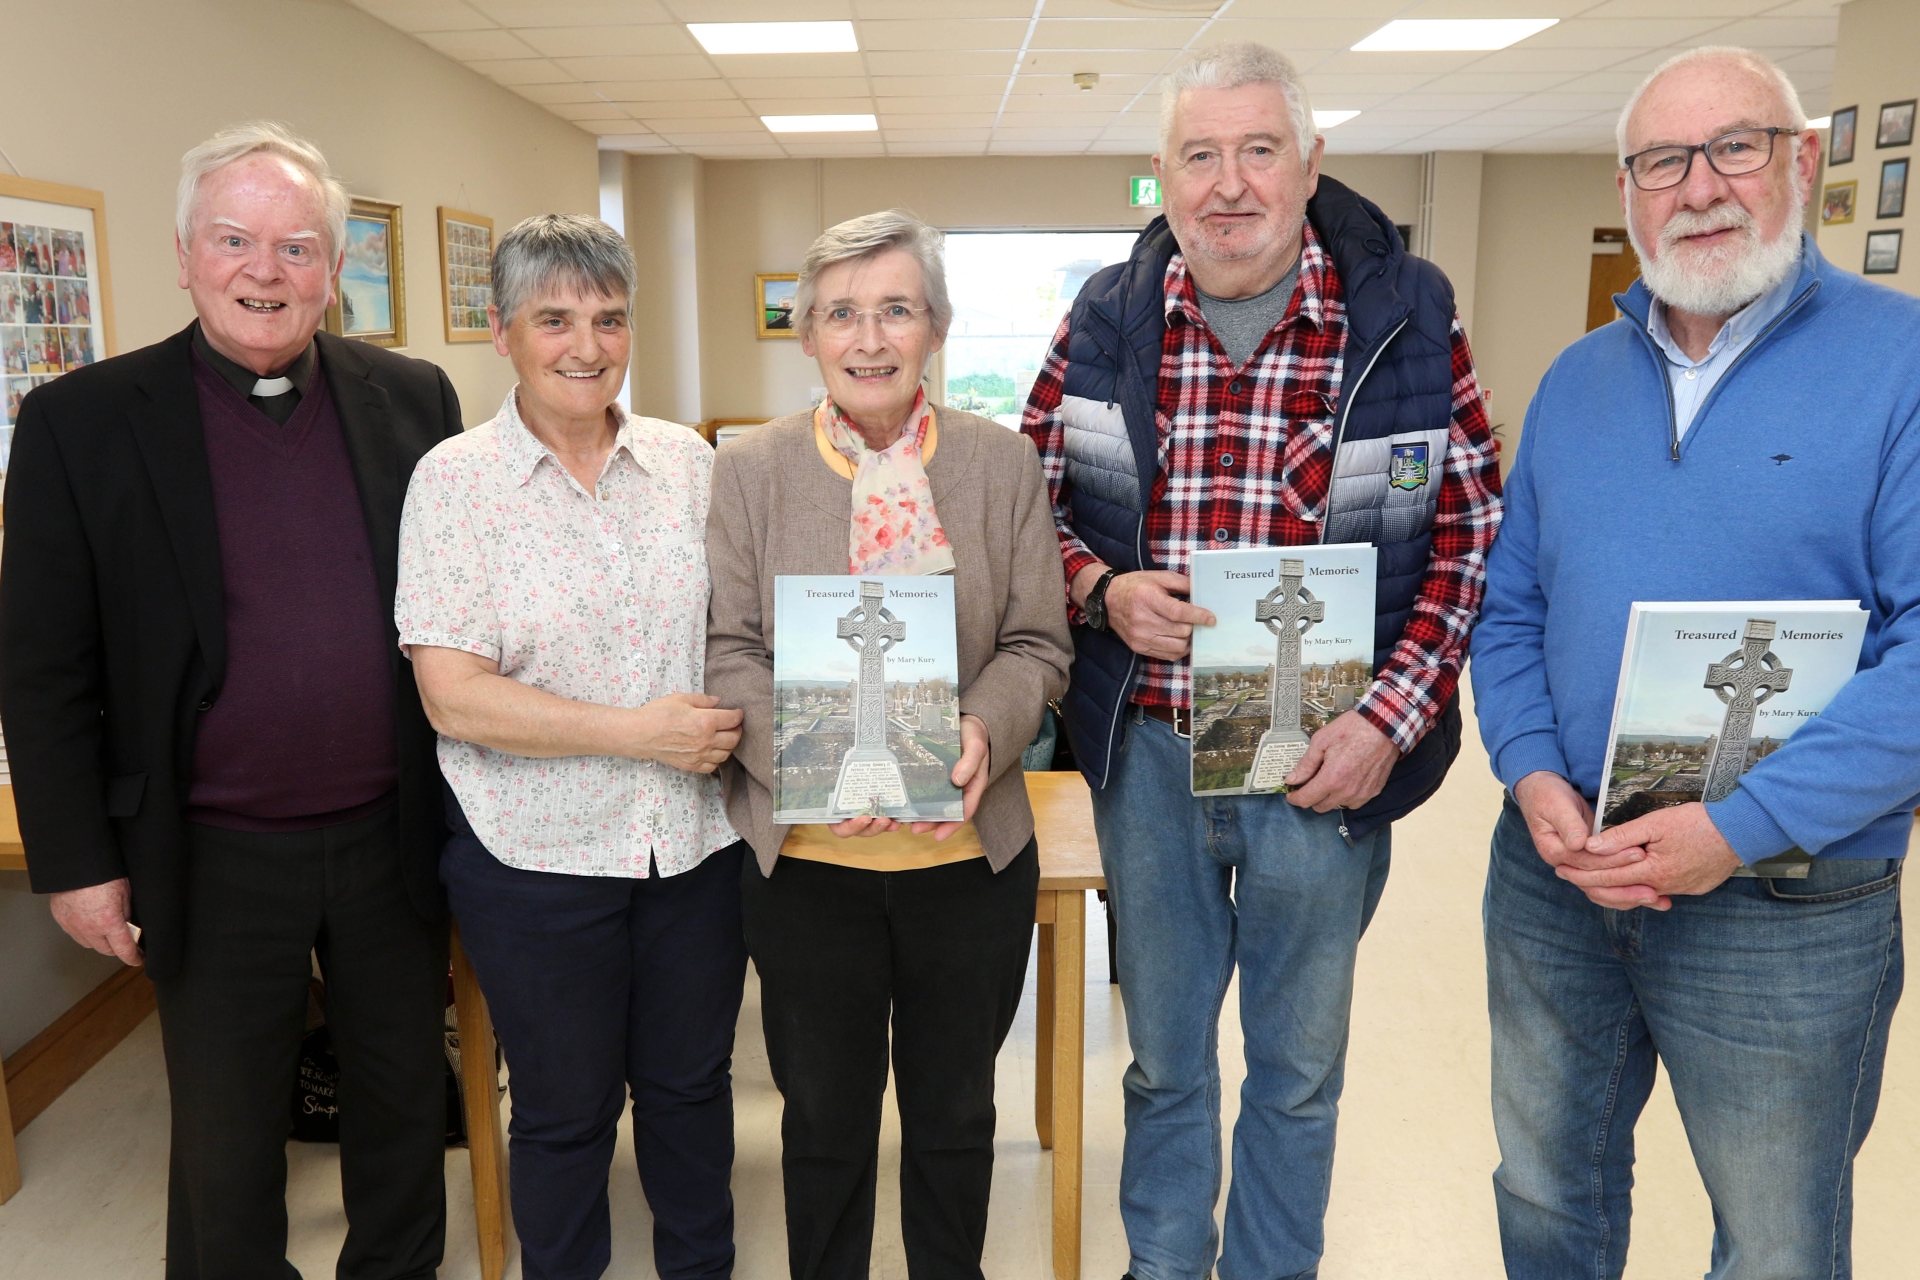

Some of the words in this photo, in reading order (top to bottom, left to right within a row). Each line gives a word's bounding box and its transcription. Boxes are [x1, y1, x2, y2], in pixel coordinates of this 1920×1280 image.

[1224, 569, 1274, 580] Treasured
[1309, 566, 1359, 576] Memories
[805, 589, 855, 598] Treasured
[889, 589, 938, 598] Memories
[1675, 629, 1737, 640] Treasured
[1780, 629, 1843, 640] Memories
[1304, 638, 1313, 646] by
[1314, 638, 1333, 646] Mary
[1335, 637, 1353, 645] Kury
[886, 656, 895, 664] by
[897, 656, 916, 664] Mary
[917, 656, 936, 664] Kury
[1759, 709, 1770, 718] by
[1771, 709, 1795, 718] Mary
[299, 1066, 314, 1078] WE
[299, 1079, 311, 1090] TO
[311, 1083, 336, 1098] MAKE
